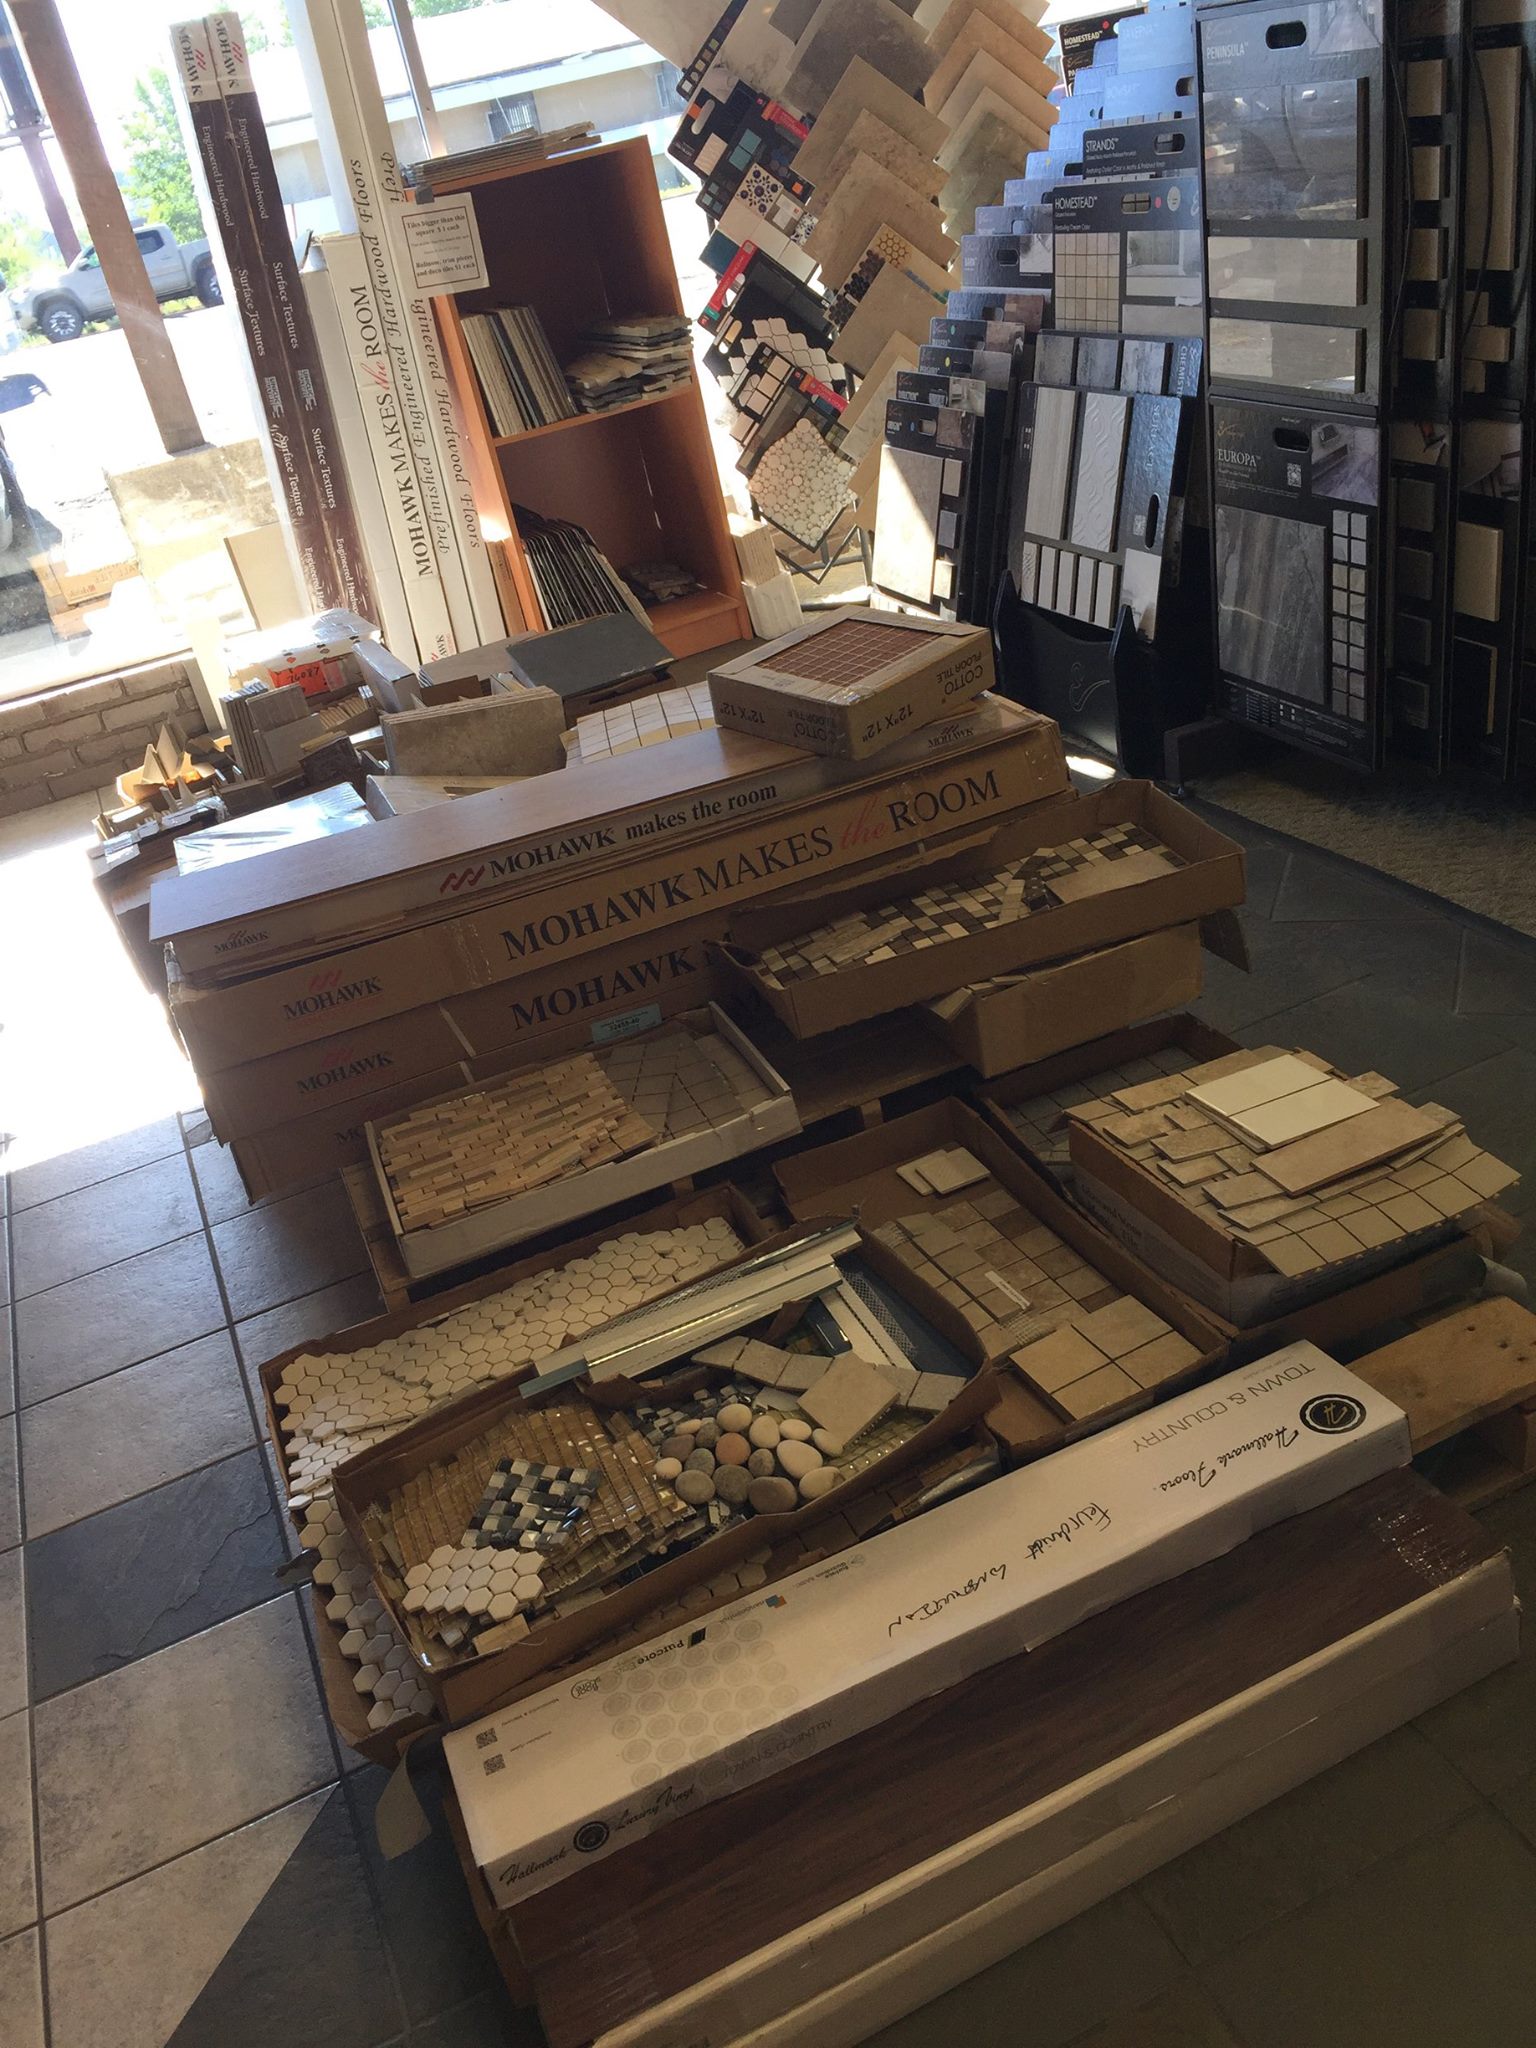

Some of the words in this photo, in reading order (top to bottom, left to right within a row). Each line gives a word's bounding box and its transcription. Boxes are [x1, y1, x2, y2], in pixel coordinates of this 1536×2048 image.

[179, 26, 203, 96] MOHAWK
[214, 17, 240, 88] MOHAWK
[202, 125, 223, 178] Engineered
[215, 179, 235, 227] Hardwood
[239, 118, 258, 170] Engineered
[251, 171, 270, 220] Hardwood
[351, 160, 374, 224] Floors
[238, 269, 255, 310] Surface
[249, 310, 266, 356] Textures
[273, 262, 288, 302] Surface
[282, 304, 299, 350] Textures
[362, 231, 402, 337] Hardwood
[350, 285, 382, 358] ROOM
[361, 360, 390, 390] the
[388, 342, 427, 447] Engineered
[1176, 345, 1188, 398] CHEMISTR
[377, 392, 410, 474] MAKES
[411, 298, 448, 381] gineered
[435, 389, 471, 488] Hardwood
[460, 493, 480, 549] Floors
[1217, 449, 1256, 467] EUROPA
[288, 474, 304, 517] Textures
[311, 428, 326, 466] Surface
[320, 467, 336, 509] Textures
[414, 452, 450, 553] Prefinished
[397, 478, 434, 576] MOHAWK
[936, 663, 954, 683] TILE
[943, 664, 984, 696] COTTO
[954, 651, 982, 672] FLOOR
[488, 827, 617, 880] MOHAWK
[625, 812, 687, 841] makes
[692, 796, 722, 823] the
[727, 785, 778, 811] room
[500, 873, 694, 961] MOHAWK
[694, 826, 833, 897] MAKES
[887, 769, 1002, 833] ROOM
[283, 975, 384, 1021] MOHAWK
[509, 946, 697, 1031] MOHAWK
[296, 1051, 394, 1094] MOHAWK
[1226, 1391, 1247, 1406] &
[1248, 1362, 1317, 1396] TOWN
[1133, 1400, 1228, 1453] COUNTRY
[1216, 1425, 1299, 1465] Hallmark
[637, 1639, 685, 1665] Purcore
[499, 1846, 567, 1886] Hallmark
[614, 1804, 661, 1832] Luxury
[653, 1785, 695, 1811] Vinyl
